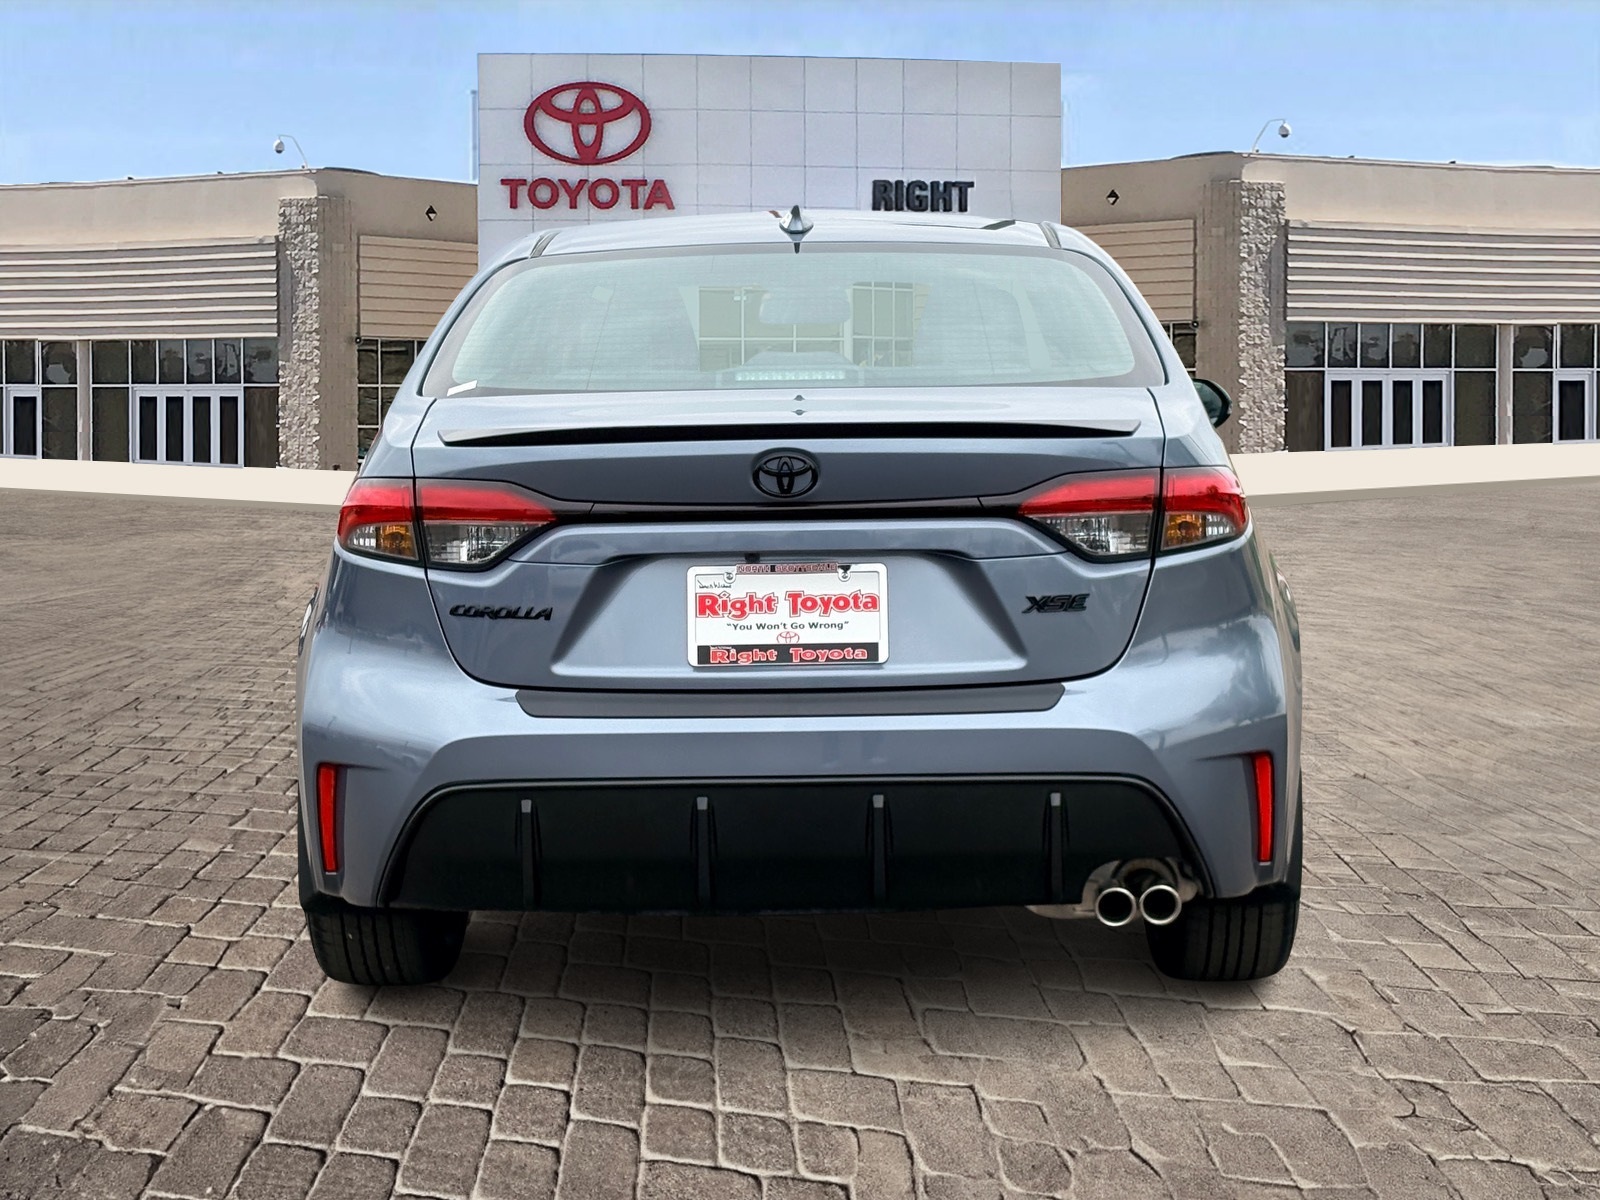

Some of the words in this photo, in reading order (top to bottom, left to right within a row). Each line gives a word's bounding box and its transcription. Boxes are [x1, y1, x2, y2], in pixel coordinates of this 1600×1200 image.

[500, 179, 675, 210] TOYOTA
[872, 179, 974, 212] RIGHT
[449, 604, 553, 621] COROLLA
[696, 591, 779, 620] Right
[785, 589, 879, 617] Toyota
[1021, 593, 1090, 613] XSE
[755, 621, 788, 631] Won't
[790, 621, 806, 630] Go
[709, 648, 778, 664] Right
[789, 647, 868, 663] Toyota
